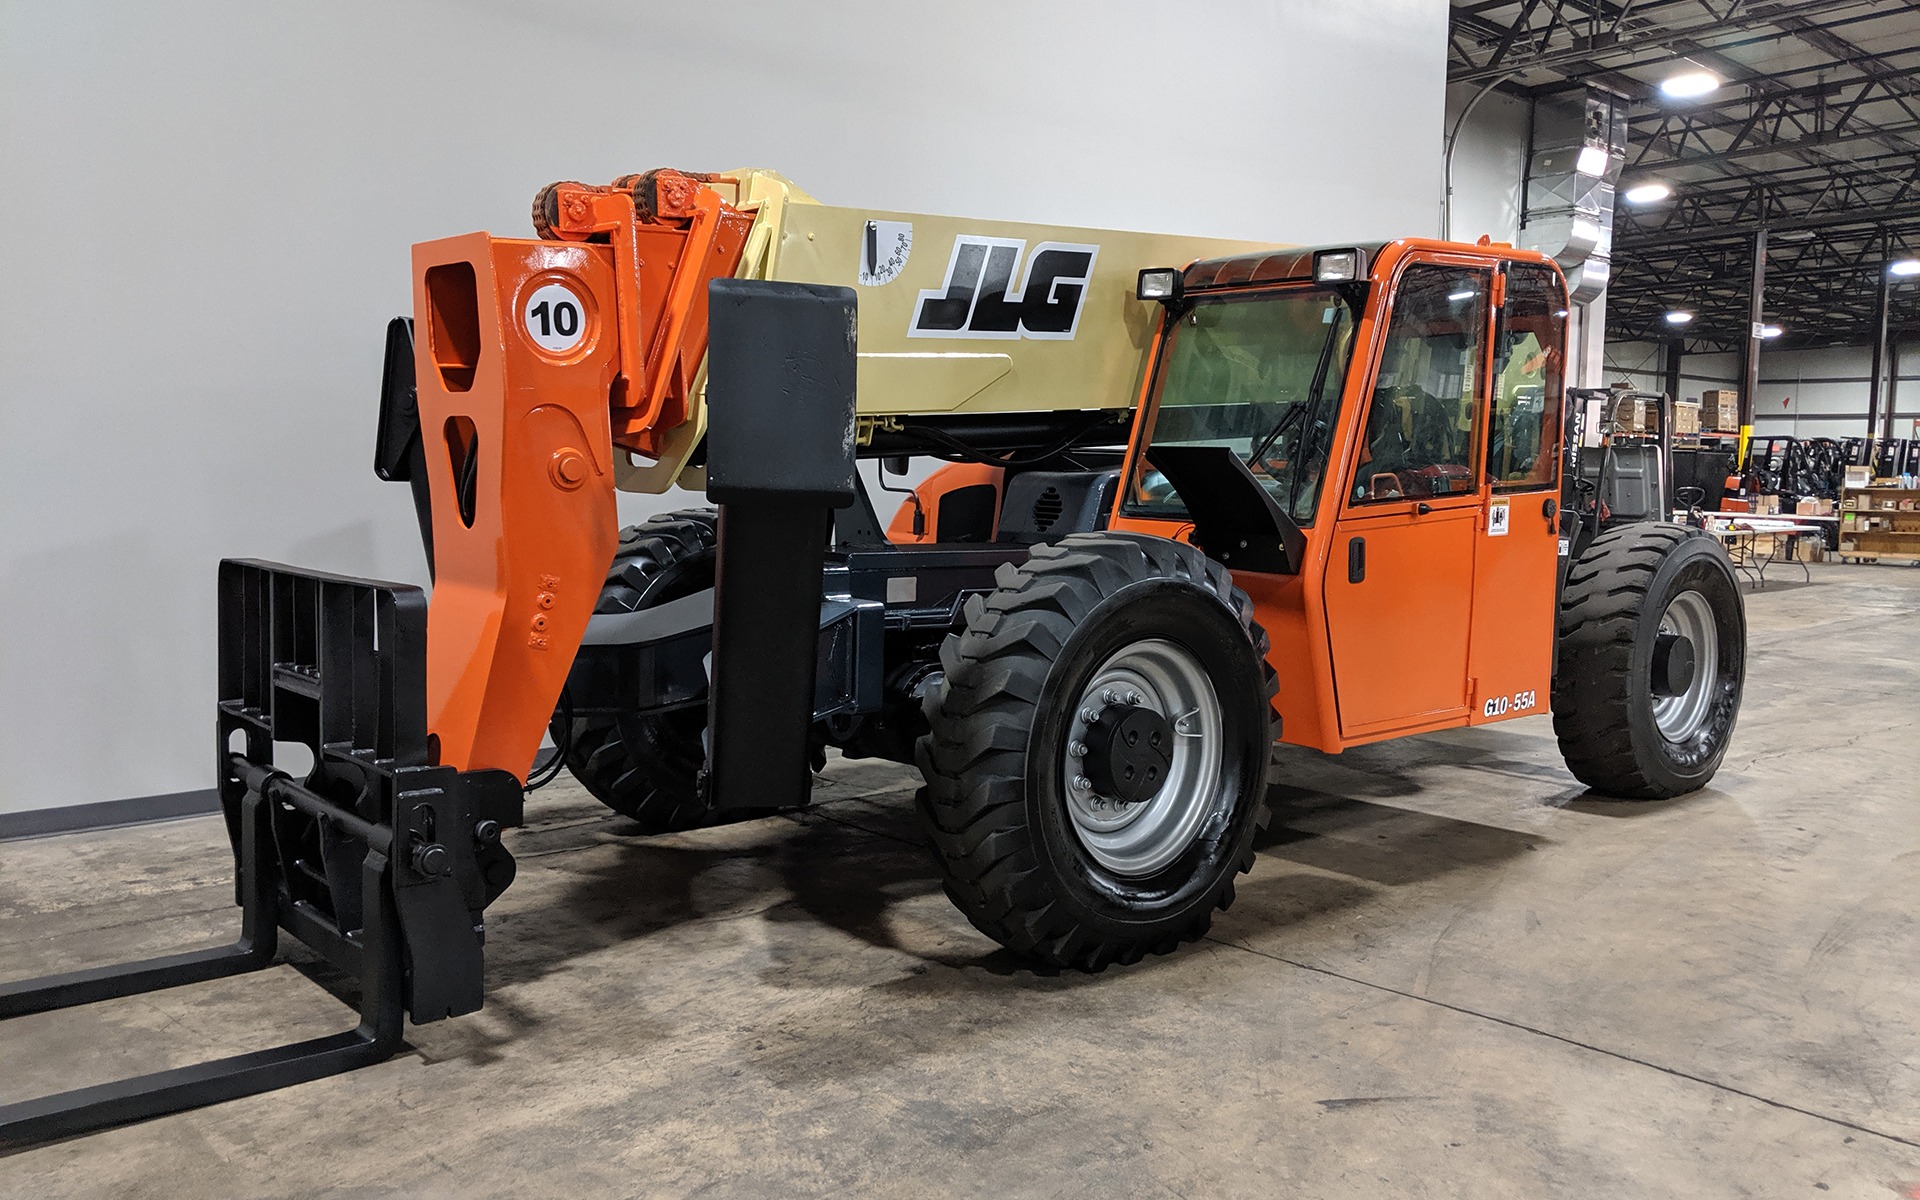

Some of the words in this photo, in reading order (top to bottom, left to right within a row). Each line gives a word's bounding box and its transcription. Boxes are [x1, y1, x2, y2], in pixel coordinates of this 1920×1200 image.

[895, 246, 902, 256] 60
[901, 242, 908, 251] 70
[888, 257, 896, 266] 40
[895, 257, 902, 266] 50
[879, 264, 886, 274] 20
[886, 267, 893, 276] 30
[874, 272, 881, 280] 10
[915, 243, 1093, 333] JLG
[531, 301, 578, 336] 10
[1571, 412, 1582, 468] NISSAN
[1484, 690, 1535, 717] G10-55A
